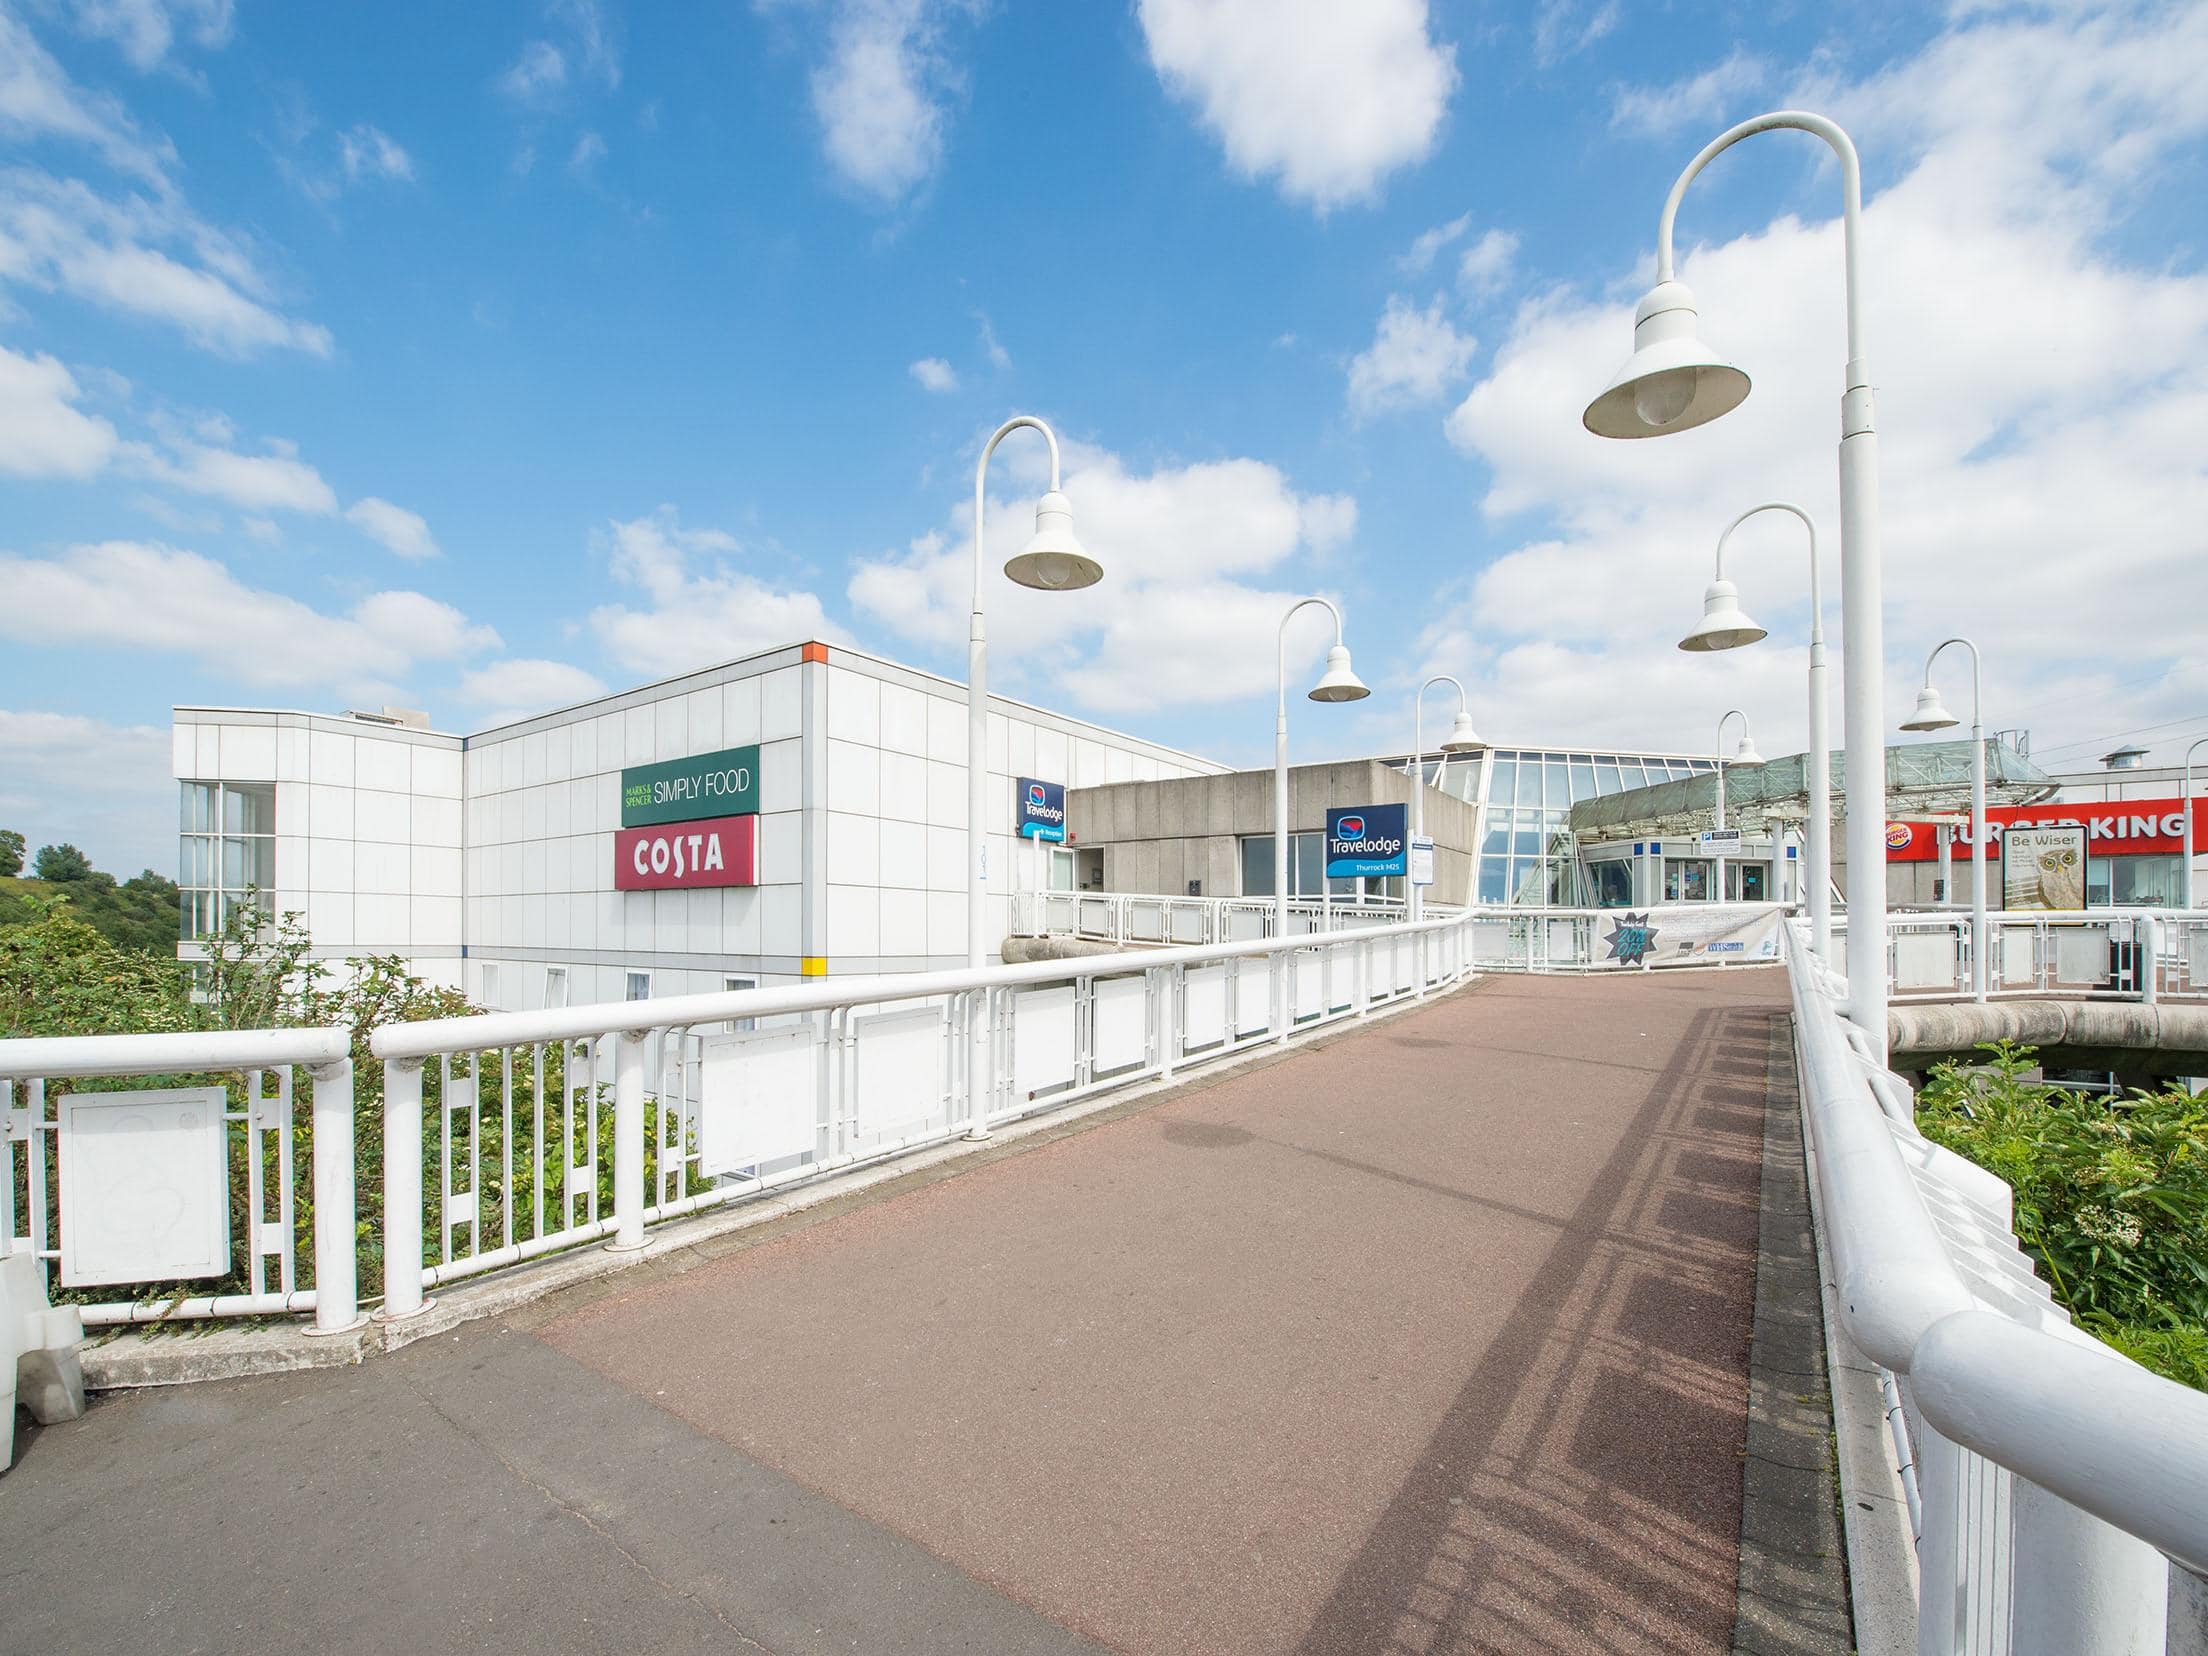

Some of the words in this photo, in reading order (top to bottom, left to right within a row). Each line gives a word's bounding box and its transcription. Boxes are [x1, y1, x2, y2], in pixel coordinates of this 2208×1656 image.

[654, 776, 702, 804] SIMPLY
[705, 768, 750, 796] FOOD
[626, 795, 652, 808] SPENCER
[1025, 801, 1063, 822] Travelodge
[2090, 812, 2186, 840] KING
[1887, 831, 1908, 842] KING
[2012, 836, 2030, 847] Be
[2035, 834, 2077, 846] Wiser
[1330, 836, 1401, 855] Travelodge
[633, 833, 724, 879] COSTA
[1356, 864, 1385, 872] Thurrock
[1386, 863, 1400, 871] M25
[1616, 943, 1645, 957] OFF
